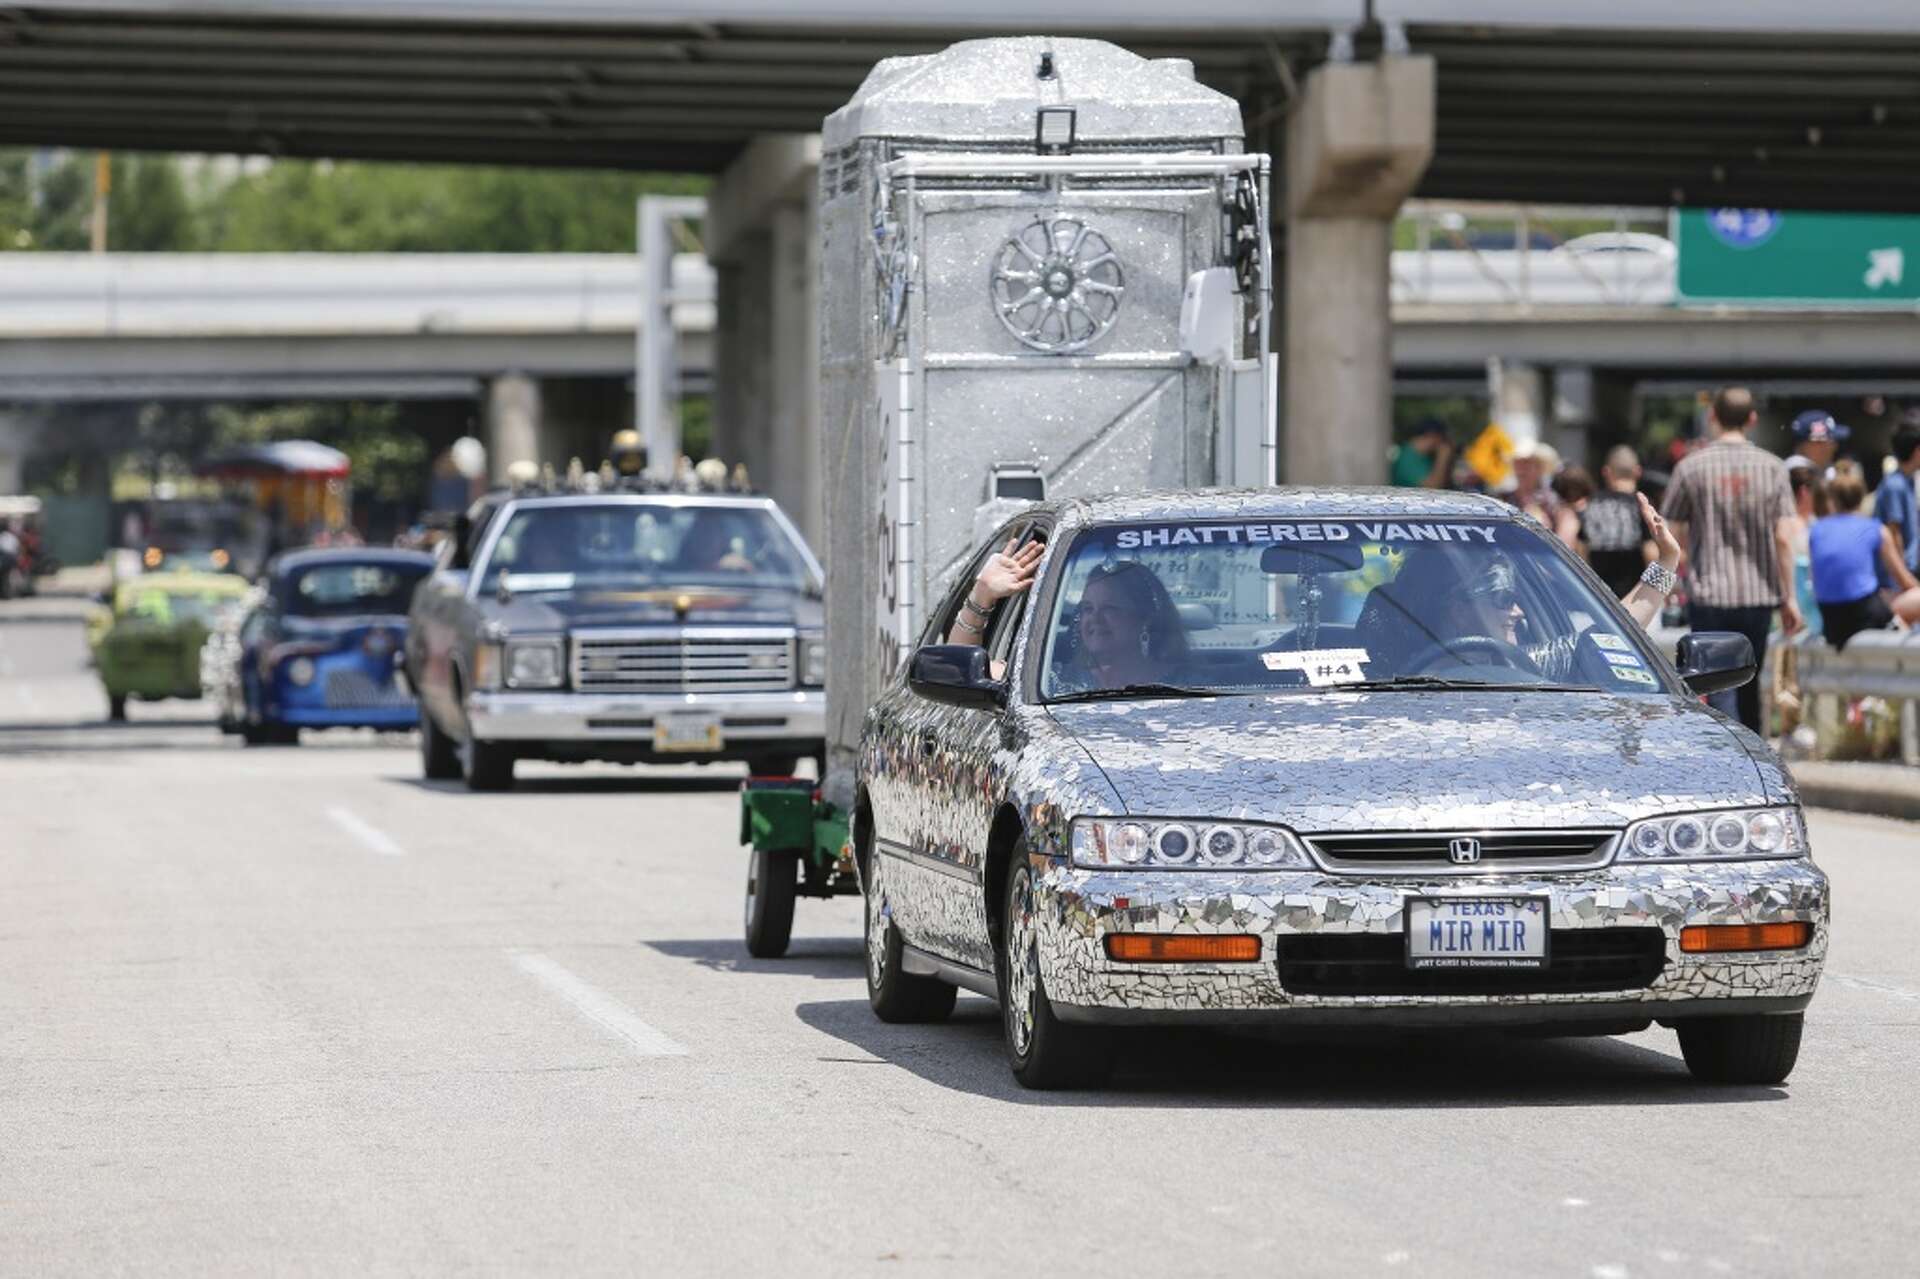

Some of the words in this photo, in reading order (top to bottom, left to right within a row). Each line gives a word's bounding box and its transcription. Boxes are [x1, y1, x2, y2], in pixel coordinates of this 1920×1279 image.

[1116, 523, 1350, 549] SHATTERED
[1355, 523, 1497, 543] VANITY
[1316, 664, 1352, 677] #4
[1451, 903, 1505, 916] TEXAS
[1430, 920, 1473, 951] MIR
[1482, 920, 1526, 951] MIR
